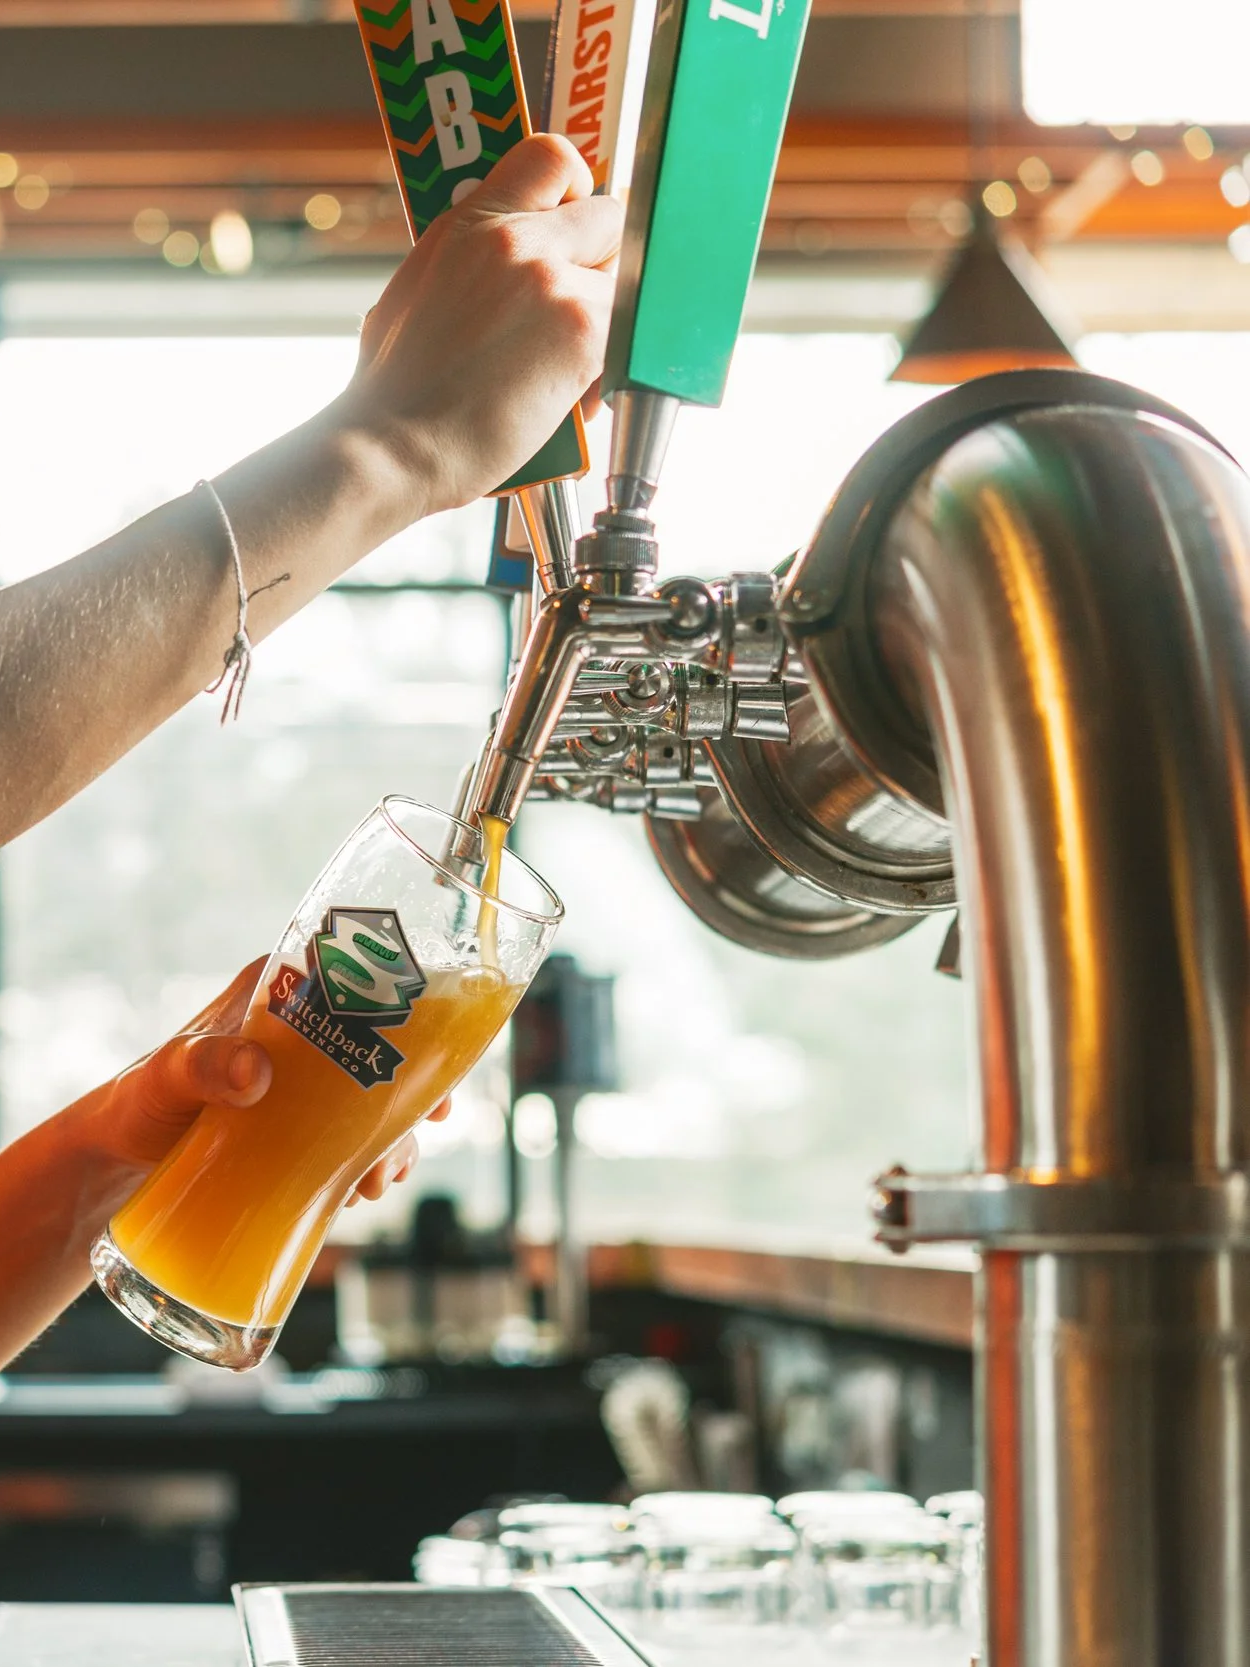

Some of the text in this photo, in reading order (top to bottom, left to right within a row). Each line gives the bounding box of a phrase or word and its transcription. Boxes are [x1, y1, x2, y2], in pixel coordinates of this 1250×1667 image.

[411, 0, 484, 205] AB
[274, 972, 384, 1075] Switchback
[280, 1008, 335, 1053] BREWING
